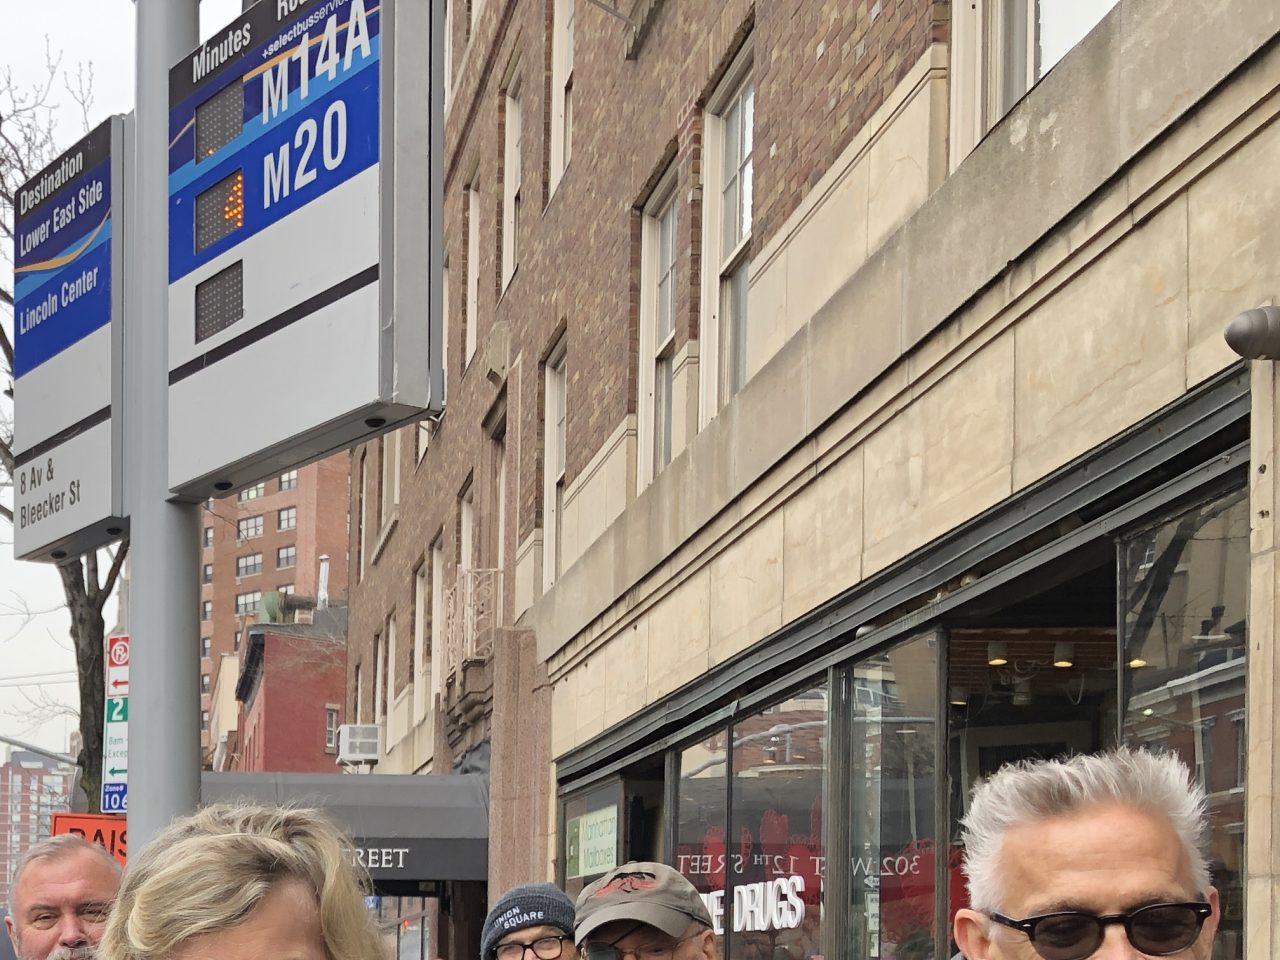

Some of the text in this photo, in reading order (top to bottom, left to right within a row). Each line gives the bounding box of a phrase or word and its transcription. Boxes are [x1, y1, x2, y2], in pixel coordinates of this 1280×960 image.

[192, 22, 251, 83] Minutes
[262, 0, 371, 125] M14A
[20, 151, 84, 216] Destination
[263, 99, 347, 210] M20
[20, 179, 103, 258] Lower East Side
[224, 174, 243, 228] 4
[20, 266, 99, 336] Lincoln Center
[20, 457, 54, 495] 8 Av &
[20, 479, 81, 529] Bleecker St
[111, 698, 124, 721] 2
[493, 905, 520, 928] UNION
[503, 911, 544, 929] SQUARE
[733, 875, 806, 933] DRUGS
